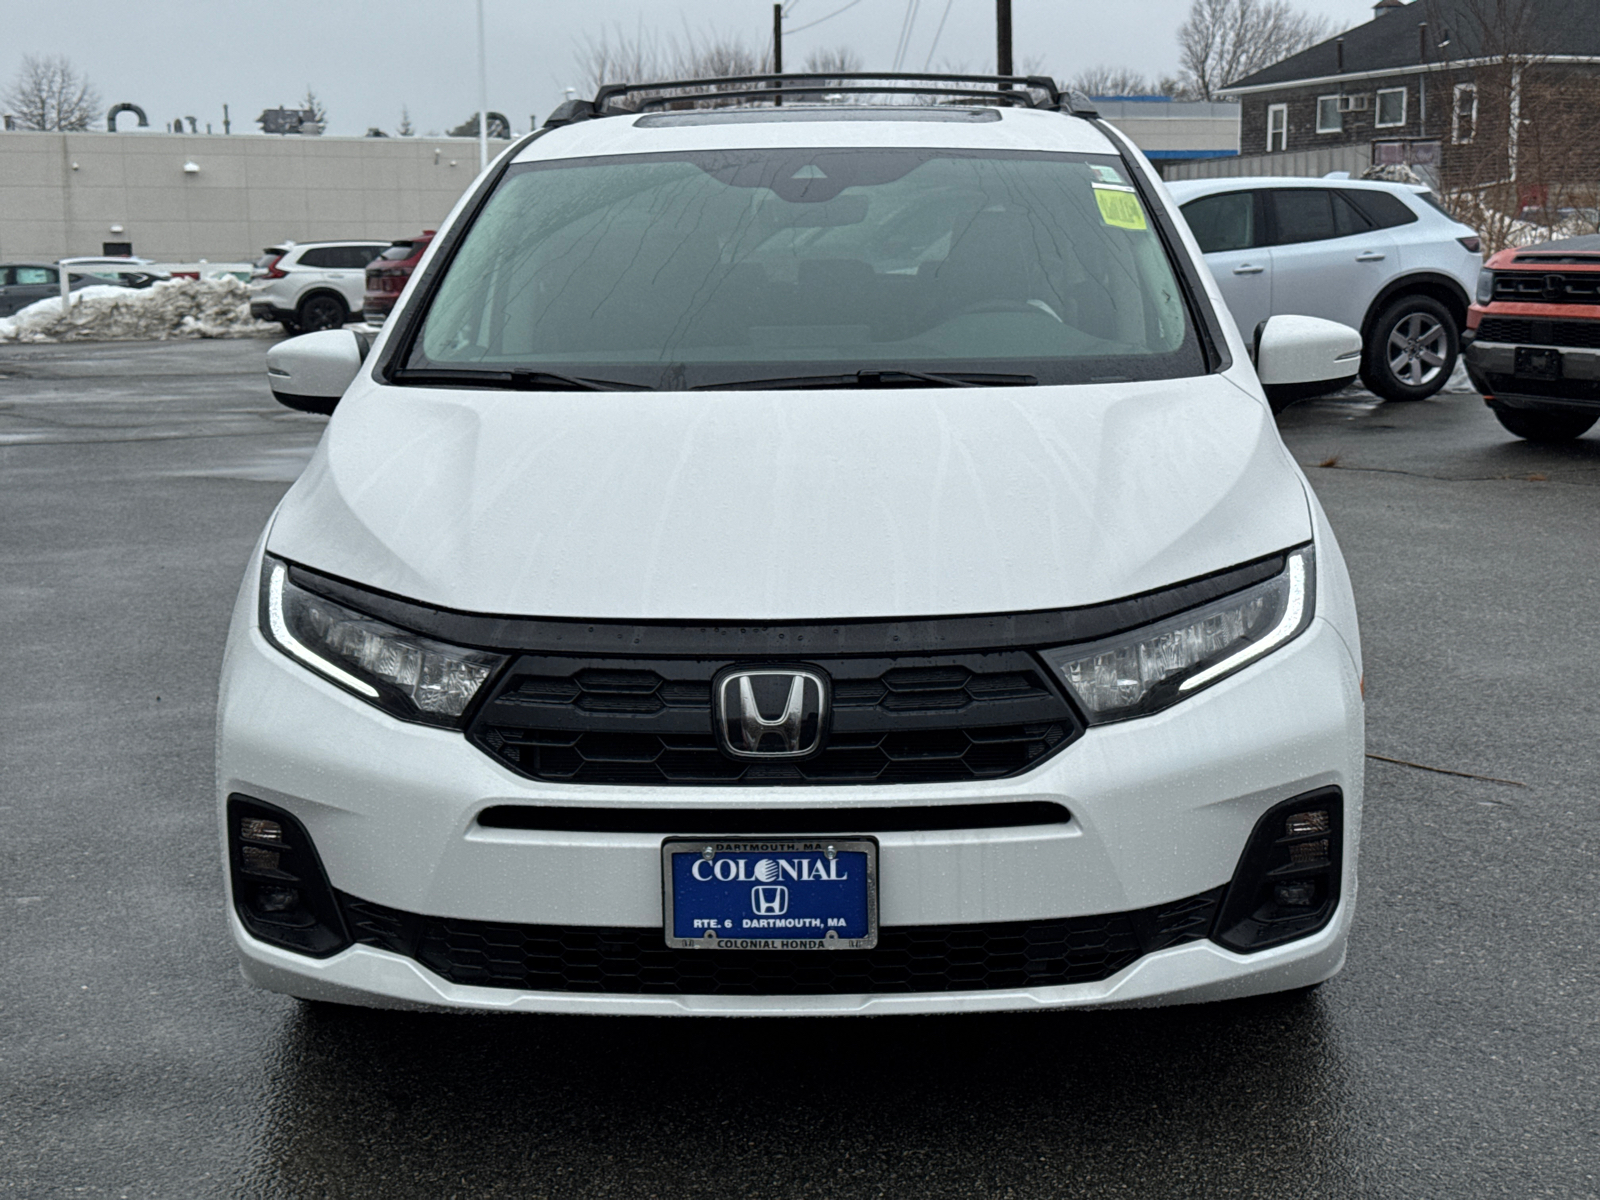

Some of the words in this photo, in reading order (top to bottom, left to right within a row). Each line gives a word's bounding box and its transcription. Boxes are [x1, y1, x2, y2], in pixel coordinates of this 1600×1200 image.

[803, 843, 822, 851] MA
[691, 858, 848, 882] COLONIAL
[693, 919, 722, 929] RTE.
[724, 919, 733, 929] 6
[742, 918, 825, 929] DARTMOUTH,
[827, 917, 847, 928] MA
[717, 939, 777, 949] COLONIAL
[781, 939, 825, 949] HONDA
